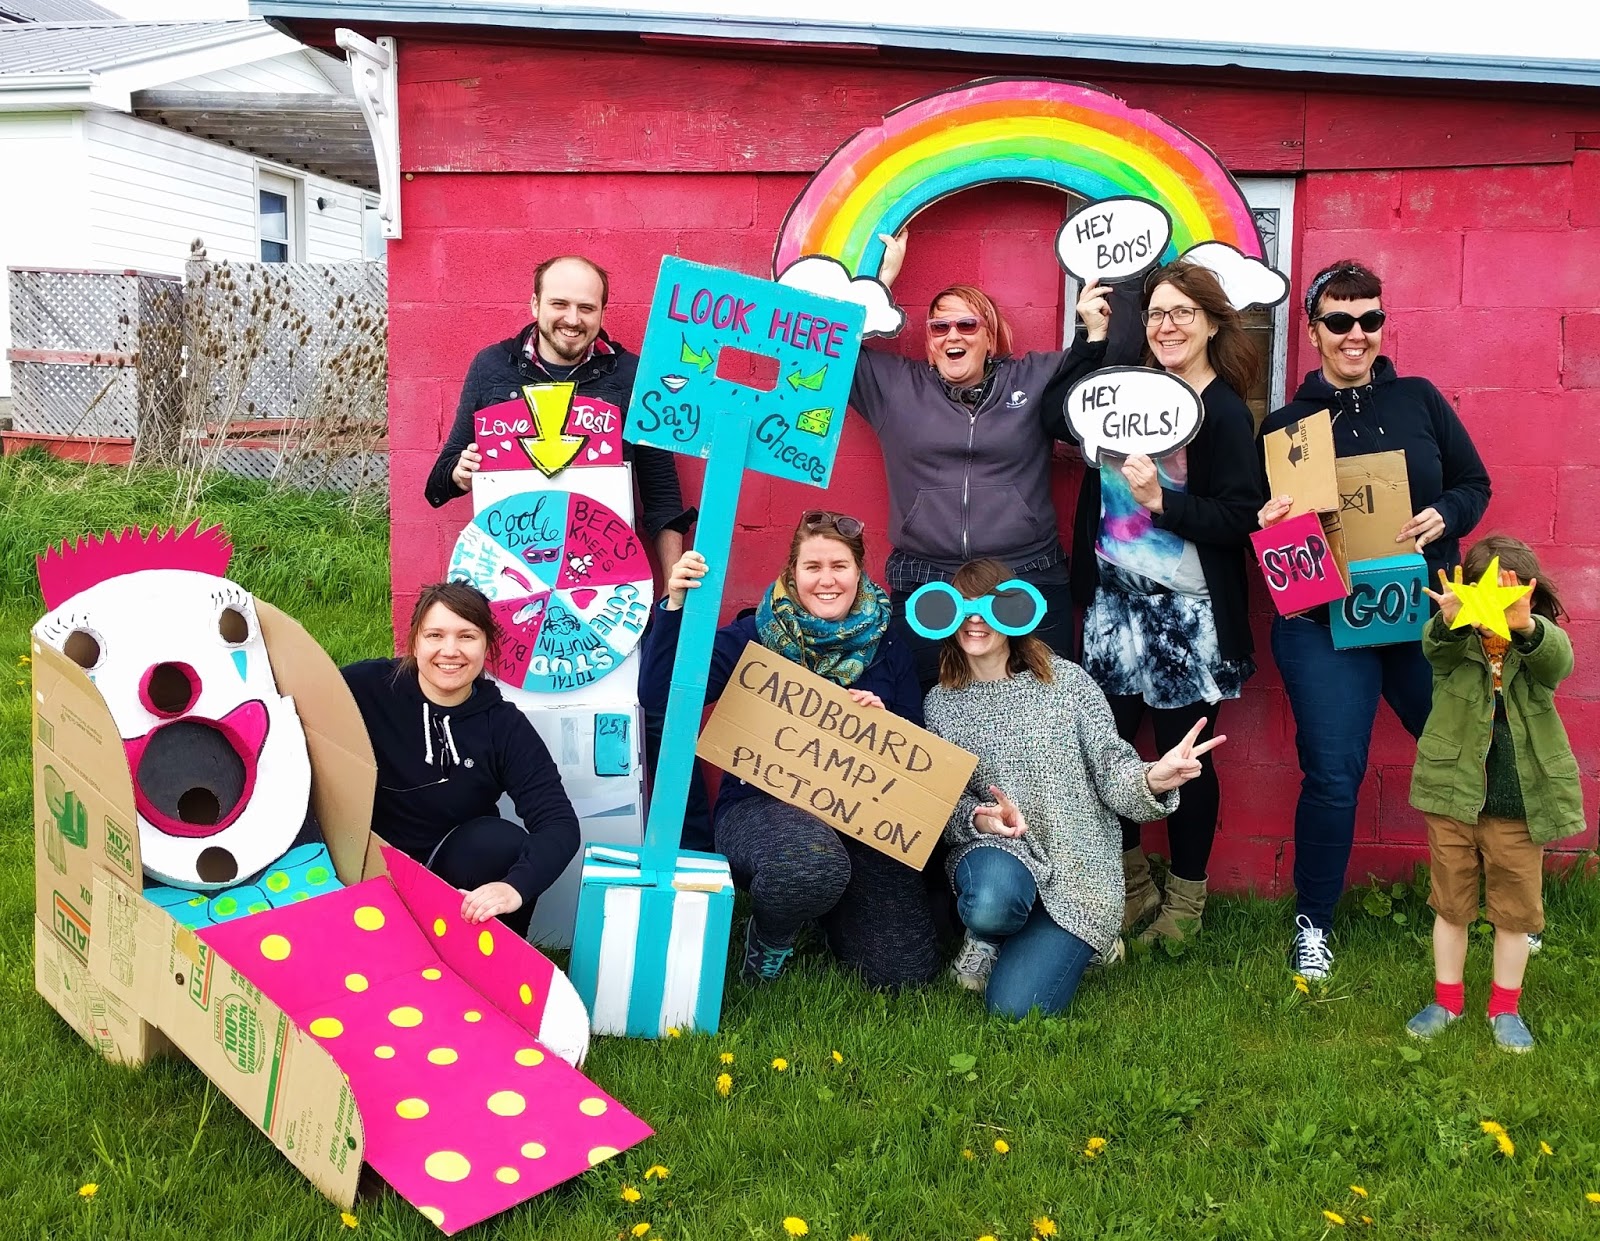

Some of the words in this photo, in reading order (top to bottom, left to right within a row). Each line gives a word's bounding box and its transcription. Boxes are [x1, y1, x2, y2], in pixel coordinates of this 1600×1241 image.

[1076, 213, 1114, 244] HEY
[1096, 229, 1153, 270] BOYS!
[668, 283, 756, 335] LOOK
[768, 308, 849, 359] HERE
[637, 390, 701, 443] Say
[1082, 384, 1121, 413] HEY
[476, 416, 531, 437] Love
[571, 404, 617, 434] Test
[1102, 407, 1180, 440] GIRLS!
[1300, 423, 1309, 443] SIDE
[756, 413, 827, 483] Cheese
[1301, 442, 1310, 463] THIS
[488, 496, 547, 537] Cool
[506, 518, 563, 548] Dude
[575, 501, 638, 561] BEE'S
[569, 520, 615, 572] KNEES
[1262, 533, 1327, 591] STOP
[588, 584, 640, 636] CUTIE
[1342, 577, 1424, 630] GO!
[530, 645, 615, 676] STUD
[539, 631, 601, 657] MUFFIN
[549, 670, 596, 690] TOTAL
[738, 660, 933, 772] CARDBOARD
[774, 726, 898, 803] CAMP!
[731, 746, 864, 836] PICTON,
[873, 819, 922, 854] ON
[224, 1002, 238, 1054] 100%
[238, 1003, 248, 1069] BUY-BACK
[313, 1122, 324, 1157] 3/27/15
[329, 1133, 340, 1166] 100%
[337, 1142, 348, 1175] Cajas
